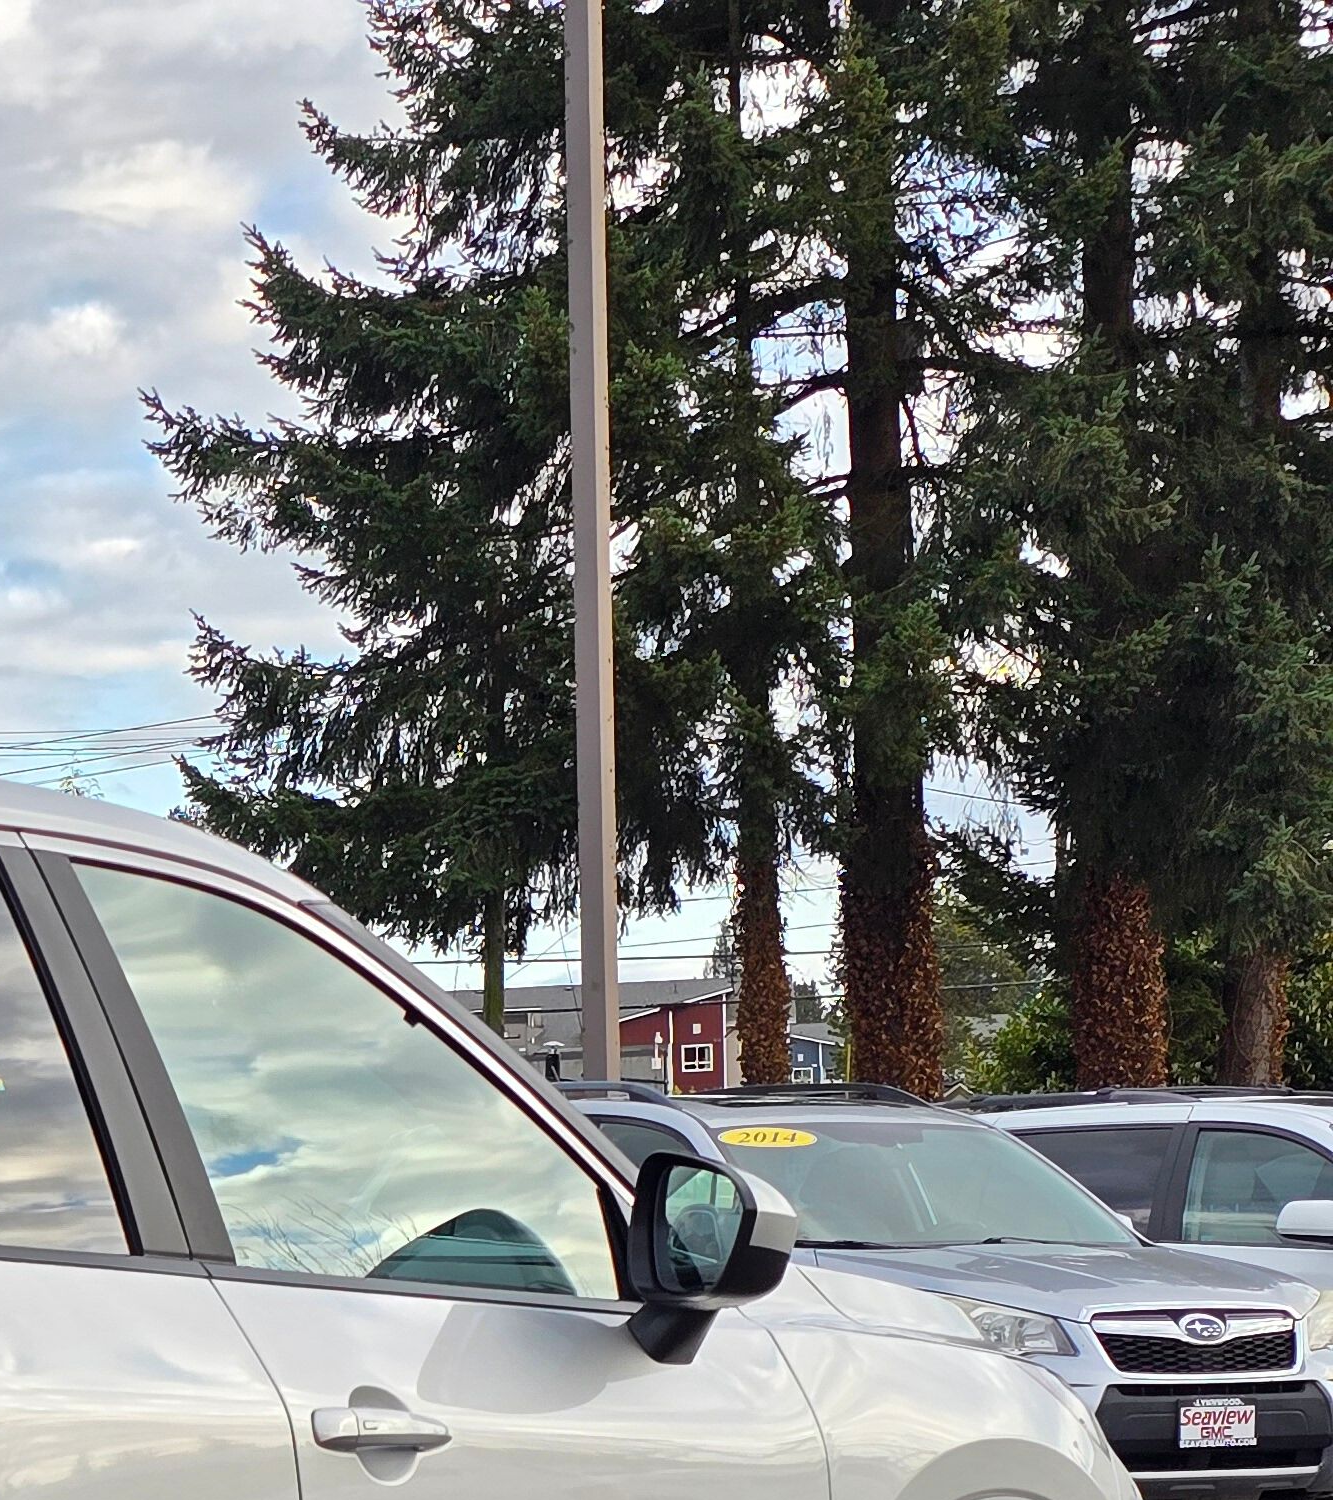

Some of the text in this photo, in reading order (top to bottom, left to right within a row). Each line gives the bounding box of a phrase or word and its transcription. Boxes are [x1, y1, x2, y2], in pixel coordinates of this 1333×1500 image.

[738, 1131, 798, 1143] 2014
[1180, 1407, 1254, 1426] Seaview
[1201, 1426, 1233, 1438] GMC
